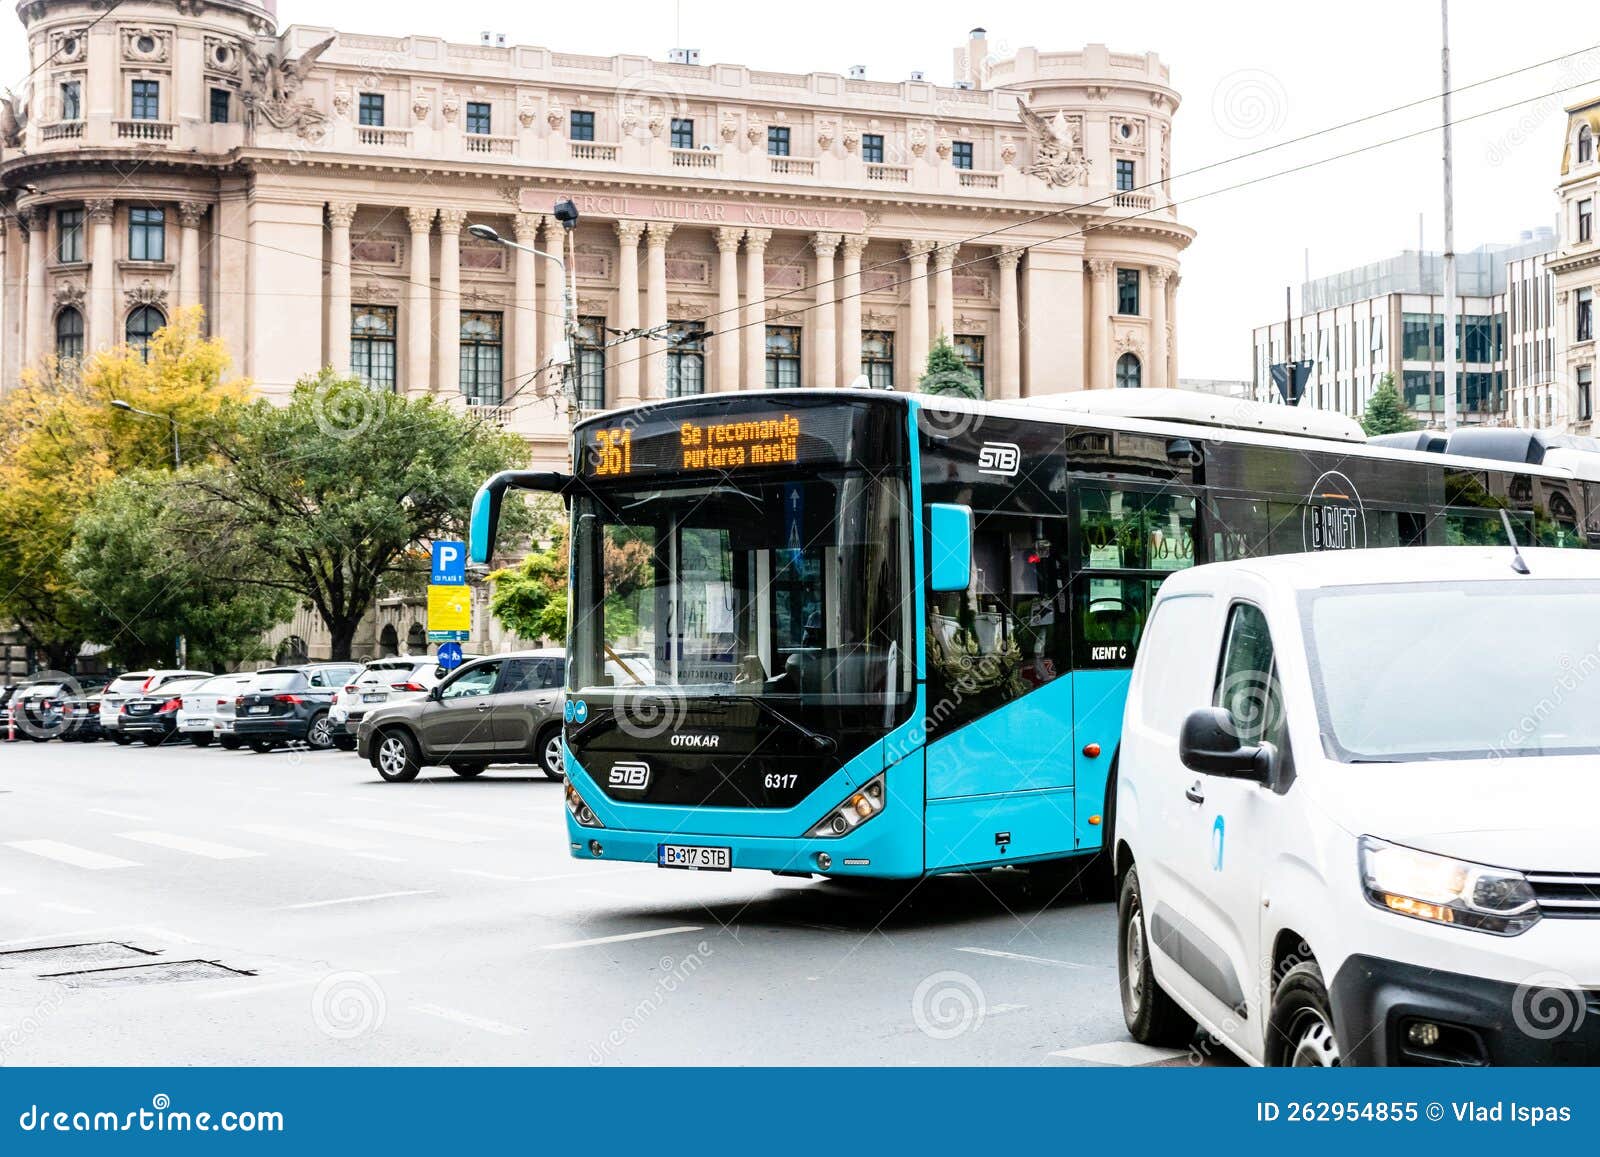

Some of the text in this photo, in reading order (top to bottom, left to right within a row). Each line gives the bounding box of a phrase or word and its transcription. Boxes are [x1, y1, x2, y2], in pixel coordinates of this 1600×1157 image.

[651, 200, 726, 222] MILITAR
[743, 206, 833, 228] NATIONAL
[680, 414, 799, 446] Se recomanda
[593, 428, 632, 475] 361
[751, 437, 797, 464] mastii
[978, 446, 1017, 471] STB
[439, 545, 458, 572] P
[1091, 647, 1127, 661] KENT C
[670, 734, 720, 748] OTOKAR
[608, 763, 648, 788] STB
[764, 773, 798, 790] 6317
[667, 847, 726, 865] B 317 STB
